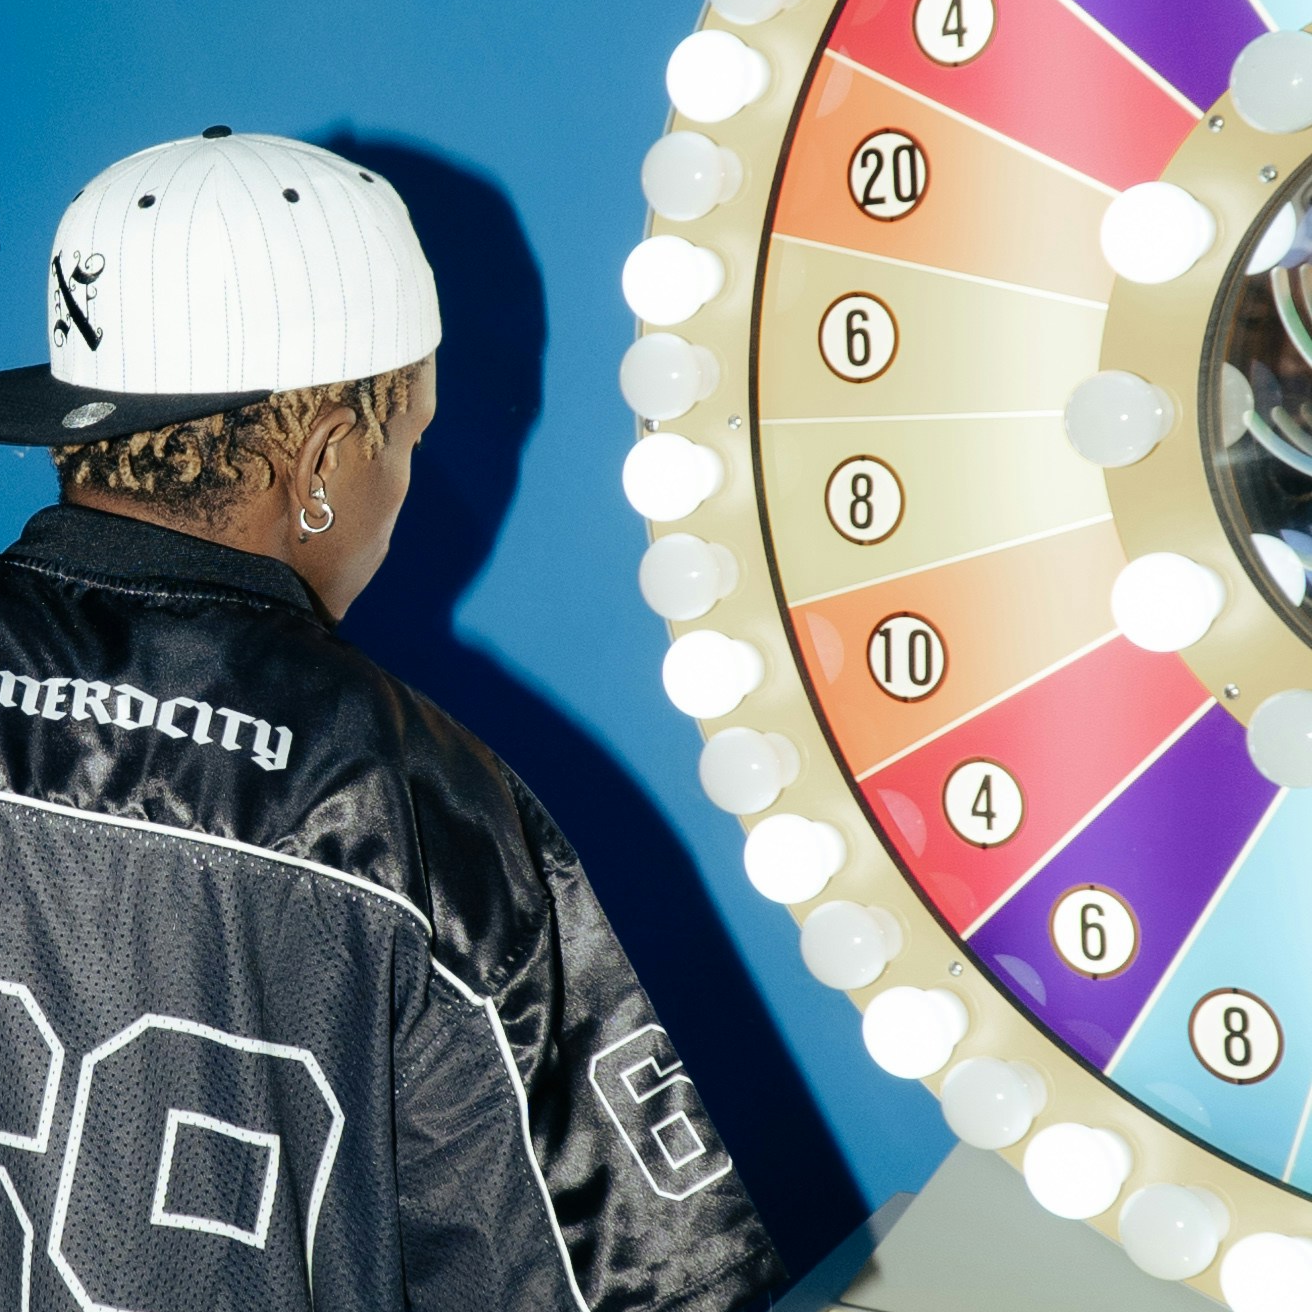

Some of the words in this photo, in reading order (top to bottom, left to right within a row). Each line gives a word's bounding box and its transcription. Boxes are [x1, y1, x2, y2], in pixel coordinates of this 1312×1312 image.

[860, 143, 919, 208] 20
[845, 308, 870, 367] 6
[849, 472, 874, 530] 8
[878, 626, 932, 688] 10
[972, 775, 997, 830] 4
[1081, 904, 1106, 961] 6
[1224, 1007, 1252, 1067] 8
